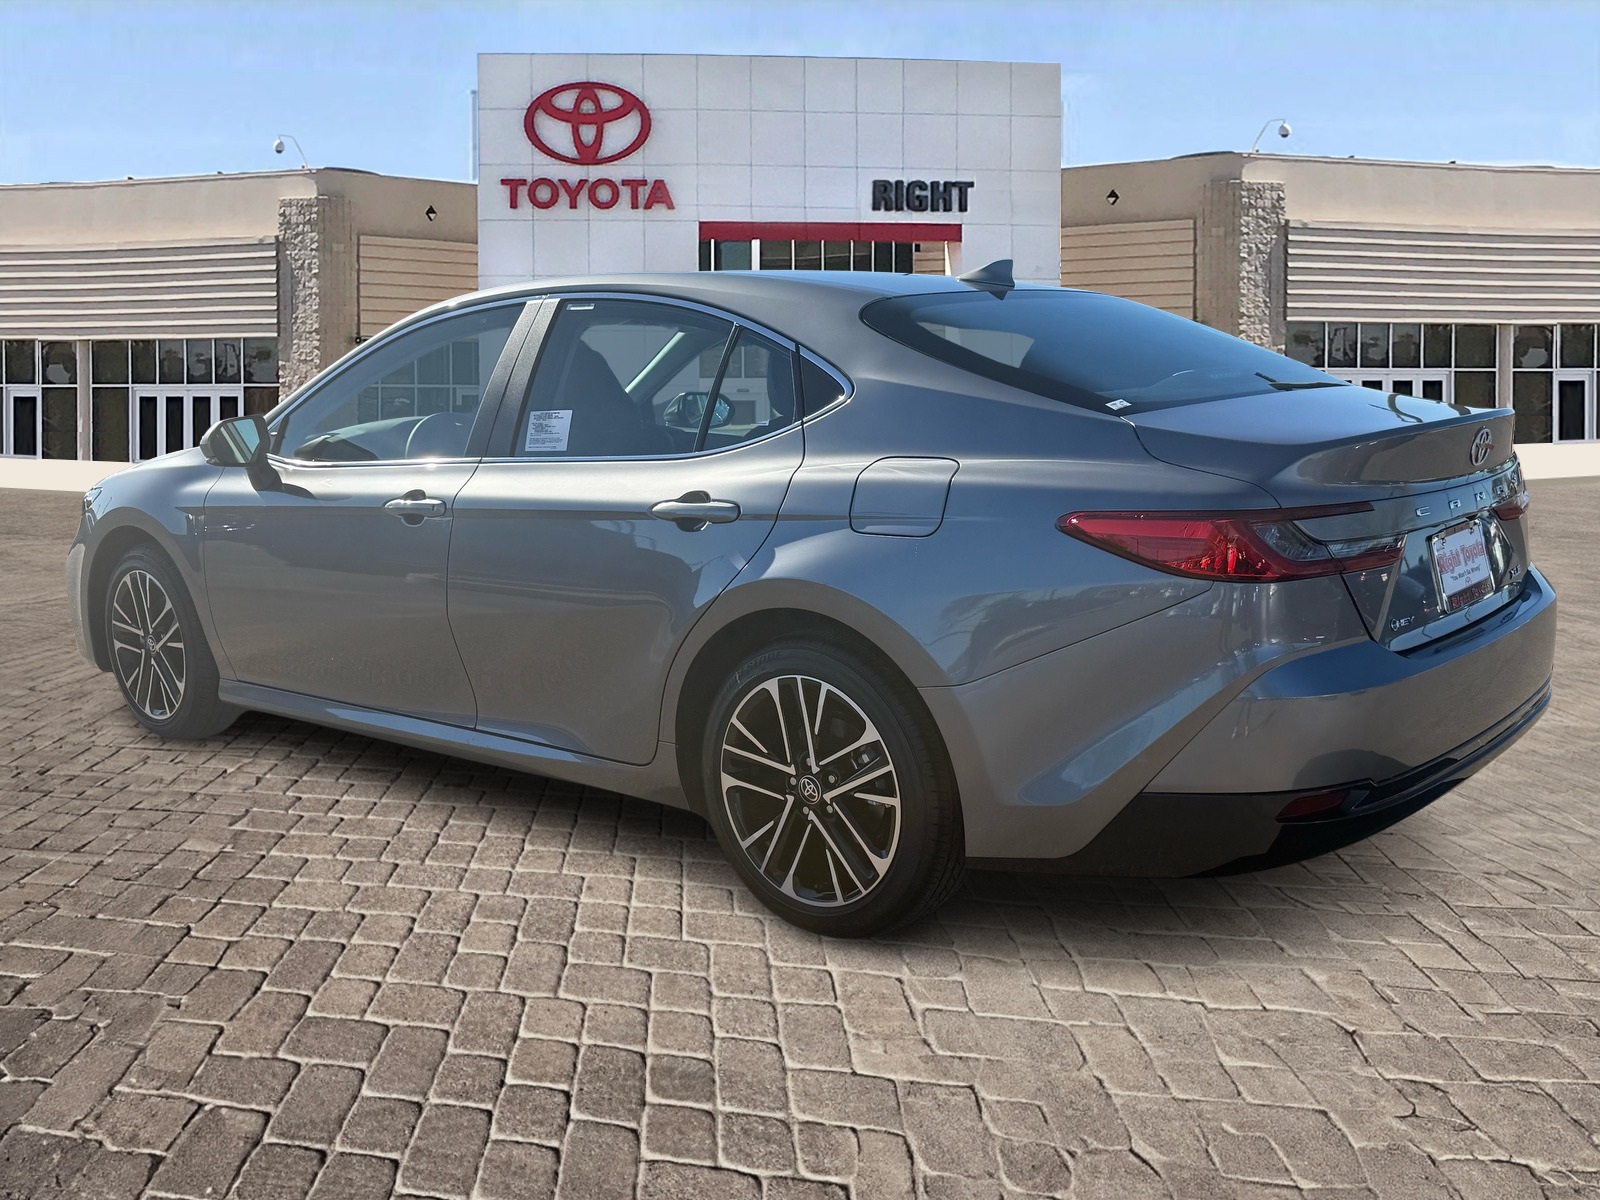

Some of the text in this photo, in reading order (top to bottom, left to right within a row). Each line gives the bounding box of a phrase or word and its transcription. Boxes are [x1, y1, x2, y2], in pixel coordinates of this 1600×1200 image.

[501, 178, 675, 210] TOYOTA
[871, 180, 975, 212] RIGHT
[1438, 541, 1485, 576] Right Toyota
